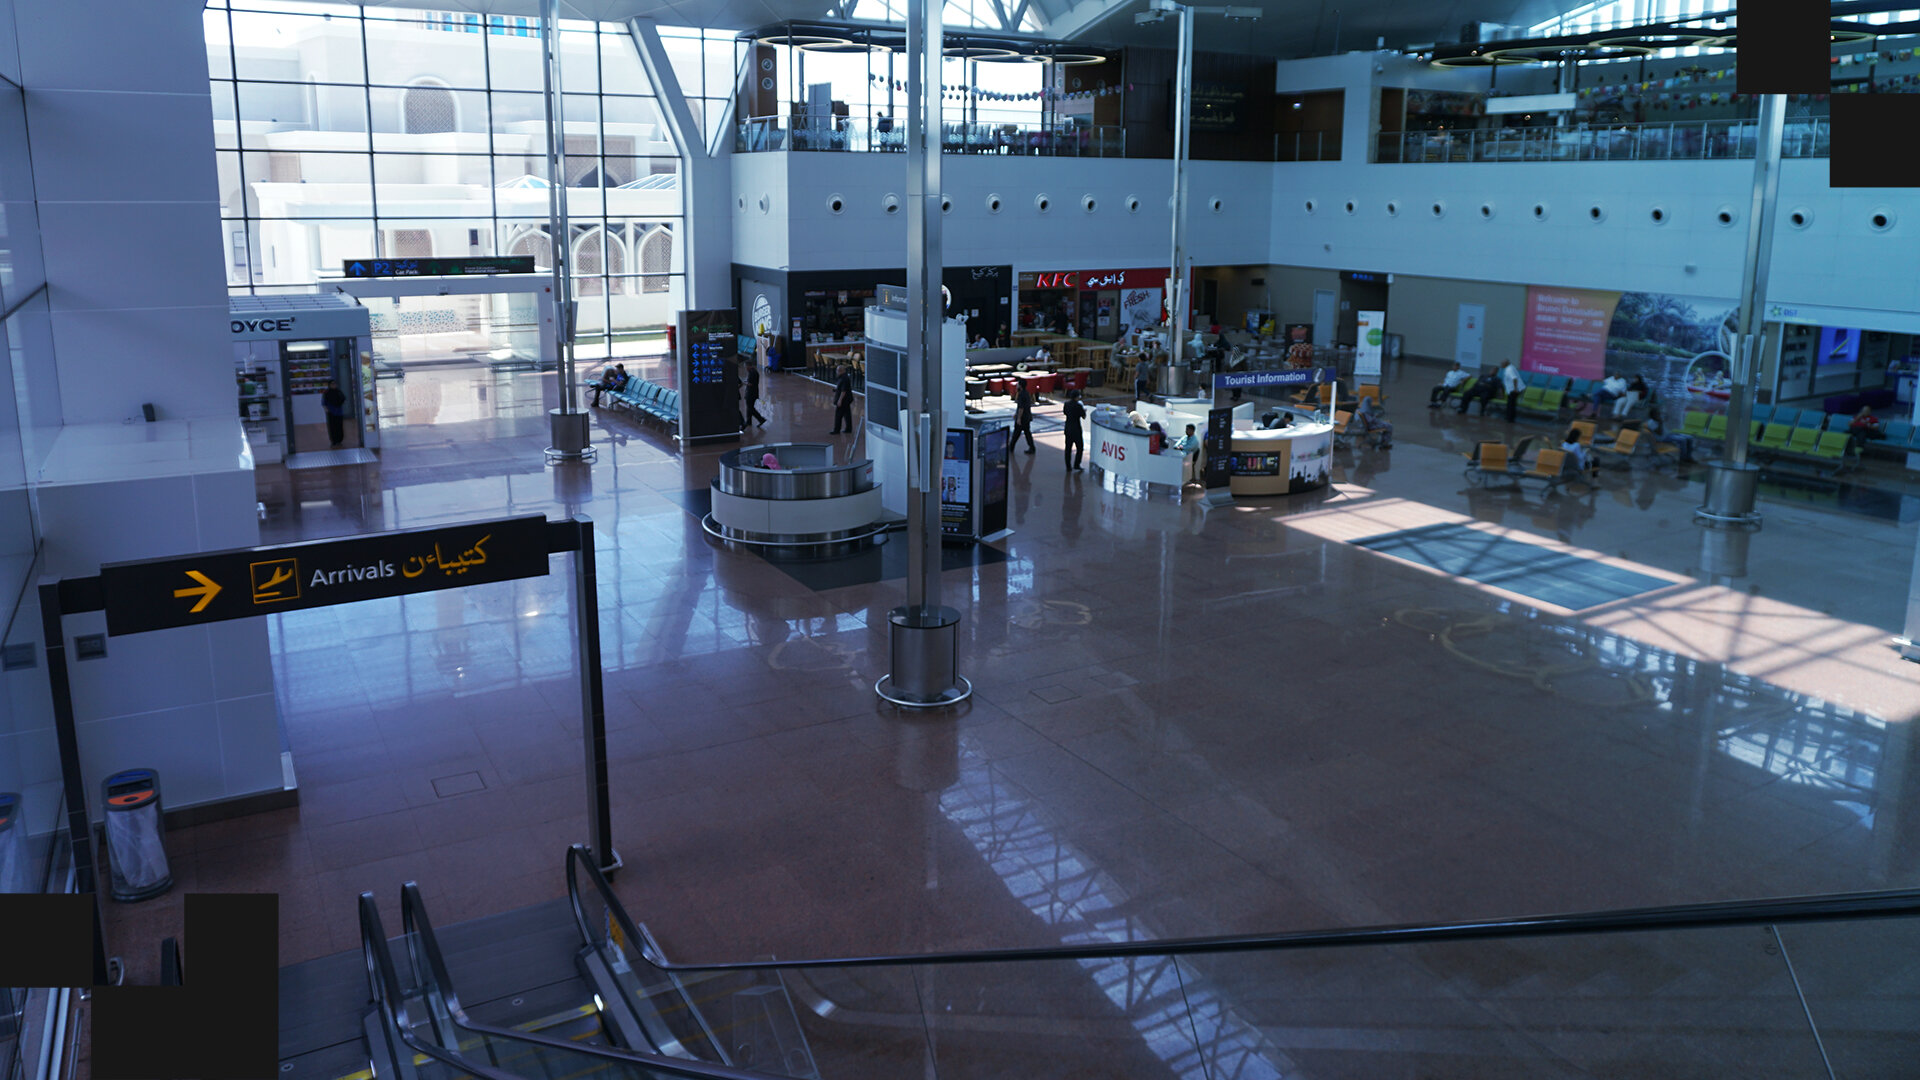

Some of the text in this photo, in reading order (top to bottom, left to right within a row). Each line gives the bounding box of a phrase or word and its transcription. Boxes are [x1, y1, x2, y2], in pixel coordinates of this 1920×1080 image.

[374, 262, 390, 274] P2
[1036, 272, 1077, 288] KFC
[1224, 373, 1306, 385] Tourist Information
[1101, 440, 1126, 462] AVIS
[310, 559, 396, 587] Arrivals
